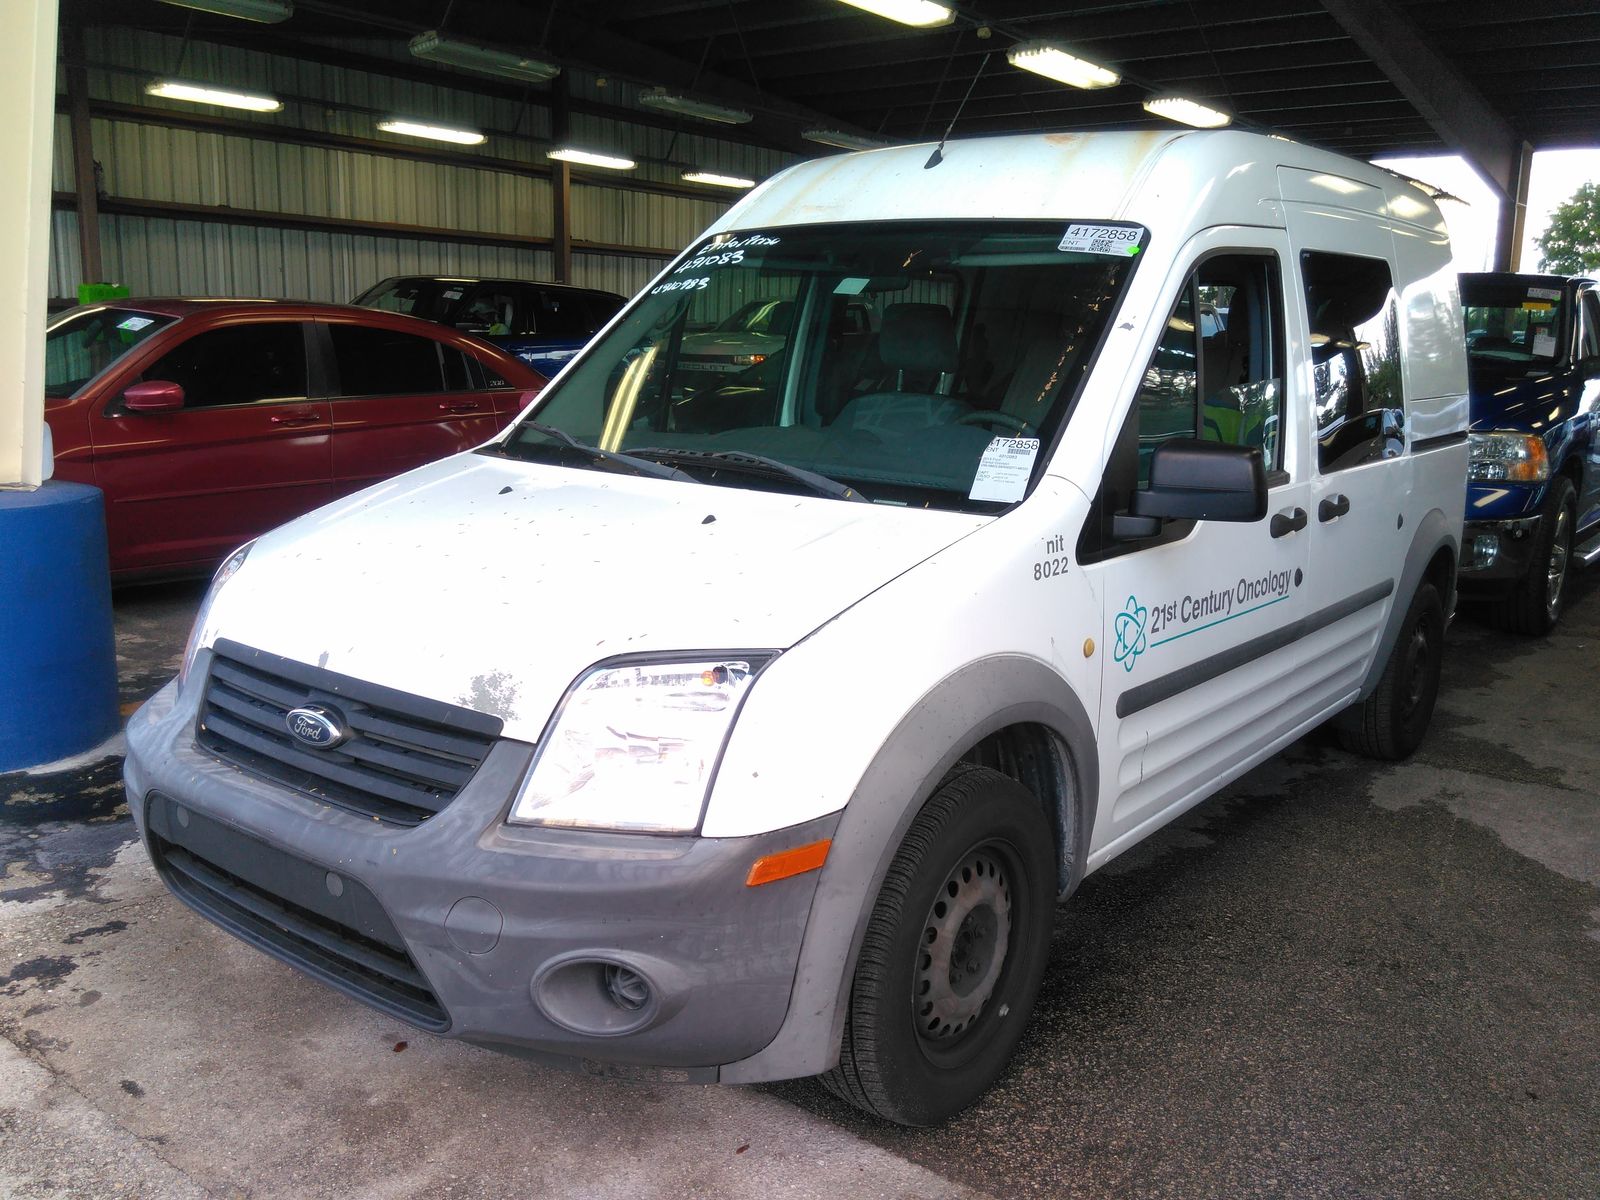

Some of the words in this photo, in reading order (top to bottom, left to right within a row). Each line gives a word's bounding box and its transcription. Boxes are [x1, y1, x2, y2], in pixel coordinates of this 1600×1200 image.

[1070, 227, 1138, 241] 4172858
[674, 249, 745, 273] 491083
[1046, 534, 1064, 554] nit
[1033, 556, 1069, 581] 8022
[1151, 600, 1177, 633] 21st
[1181, 587, 1235, 623] Century
[1237, 569, 1292, 605] Oncology
[294, 715, 322, 740] Ford
